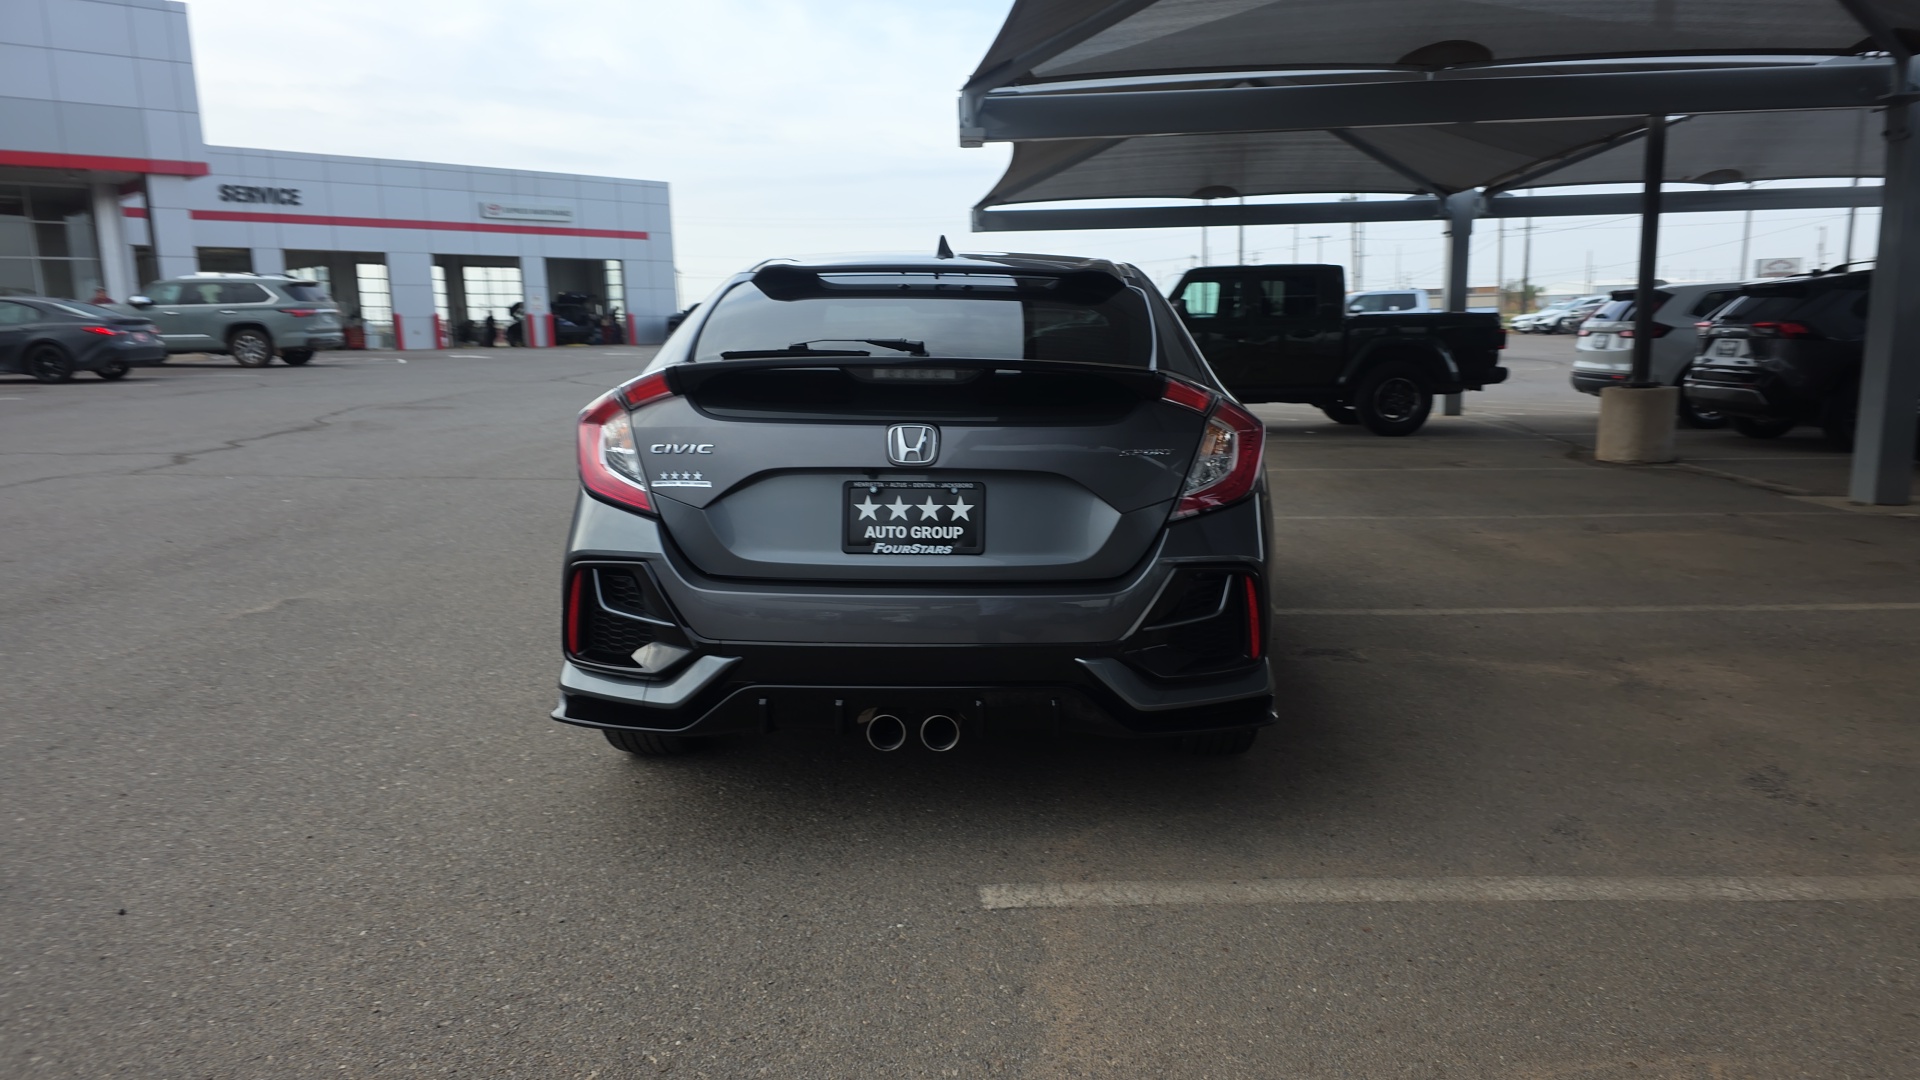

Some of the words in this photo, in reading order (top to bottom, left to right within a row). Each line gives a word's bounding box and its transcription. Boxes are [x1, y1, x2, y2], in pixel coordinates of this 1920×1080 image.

[218, 184, 302, 206] SERVICE
[650, 443, 714, 454] CIVIC
[864, 526, 907, 539] AUTO
[910, 526, 964, 539] GROUP
